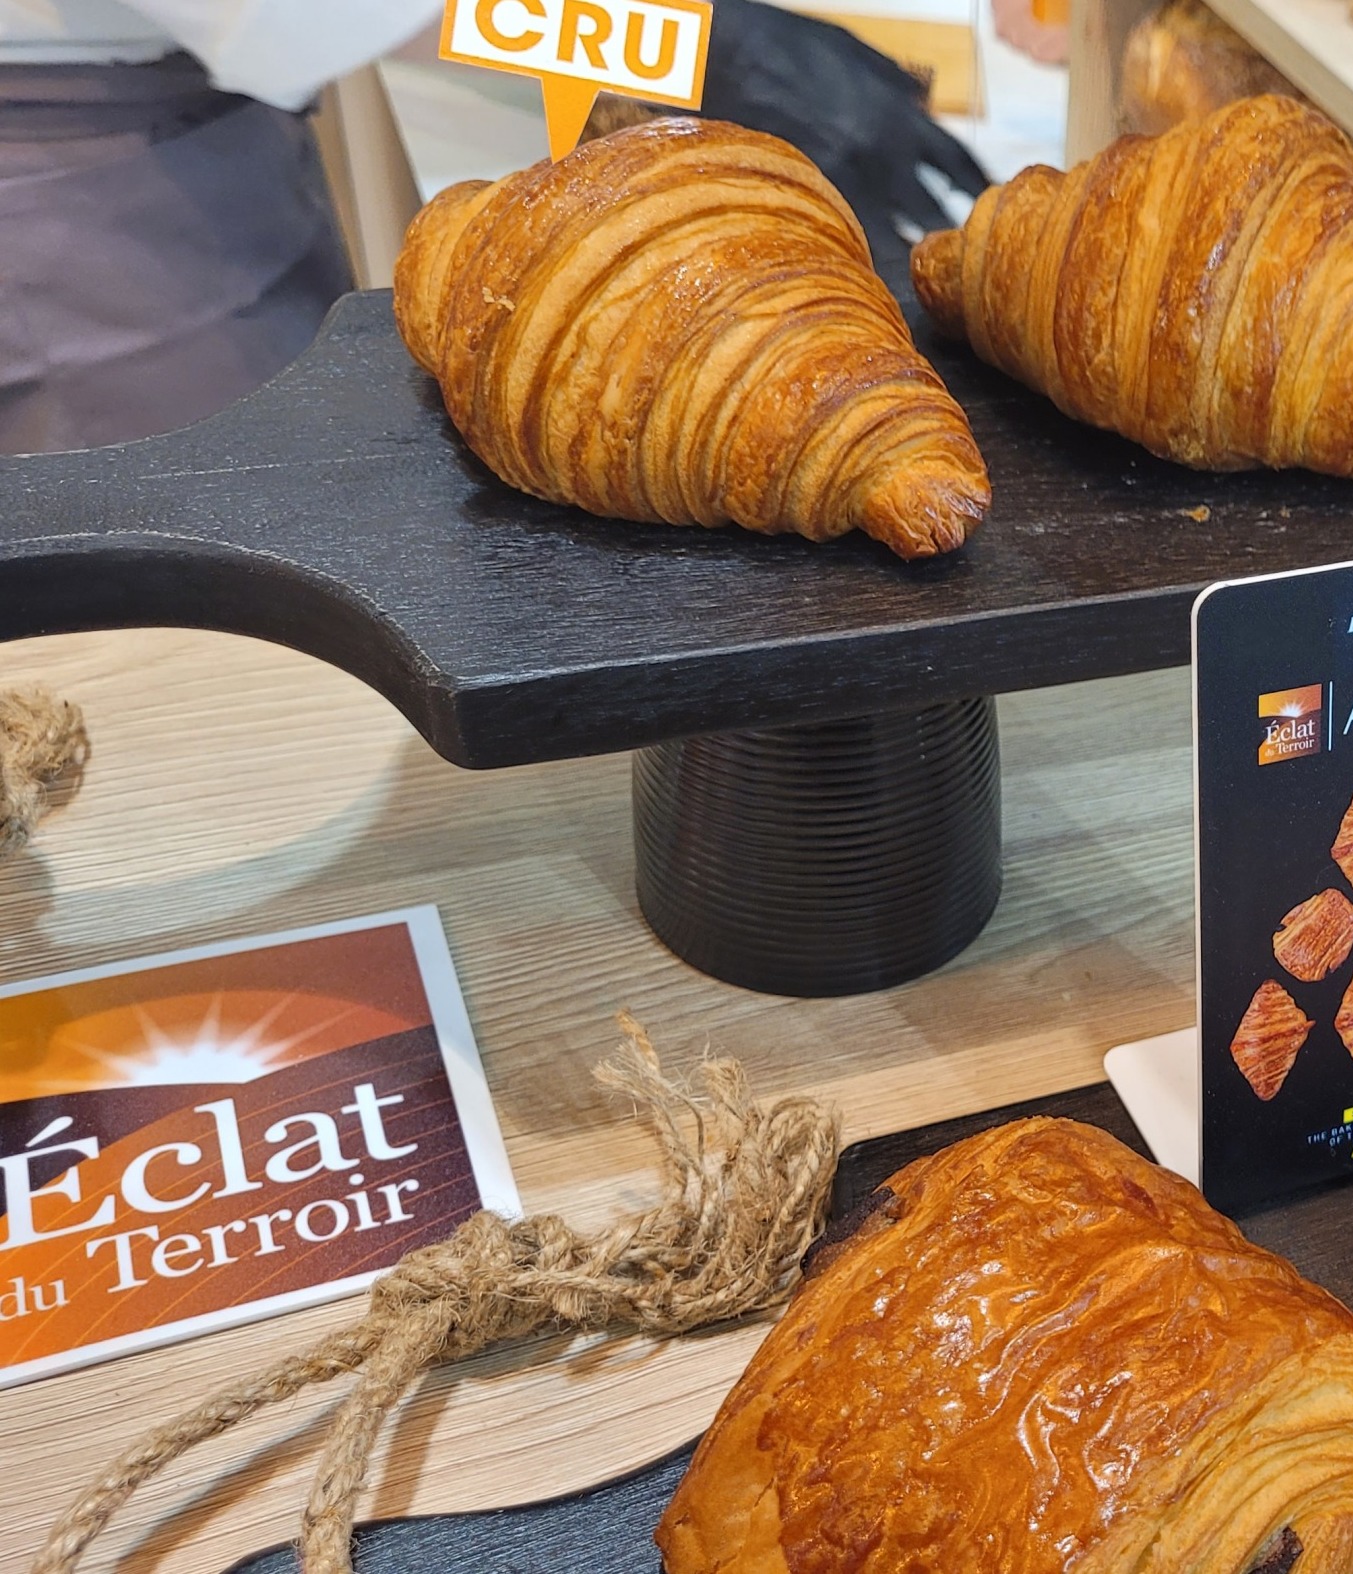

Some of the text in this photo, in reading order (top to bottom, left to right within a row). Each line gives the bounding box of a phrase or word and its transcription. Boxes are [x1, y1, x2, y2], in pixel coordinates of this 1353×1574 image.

[475, 0, 680, 80] CRU
[1265, 719, 1315, 744] Éclat
[1275, 737, 1315, 755] Terroir
[1307, 1131, 1328, 1145] THE
[1329, 1135, 1344, 1147] OF
[0, 1083, 418, 1251] Éclat
[0, 1173, 419, 1323] du Terroir
